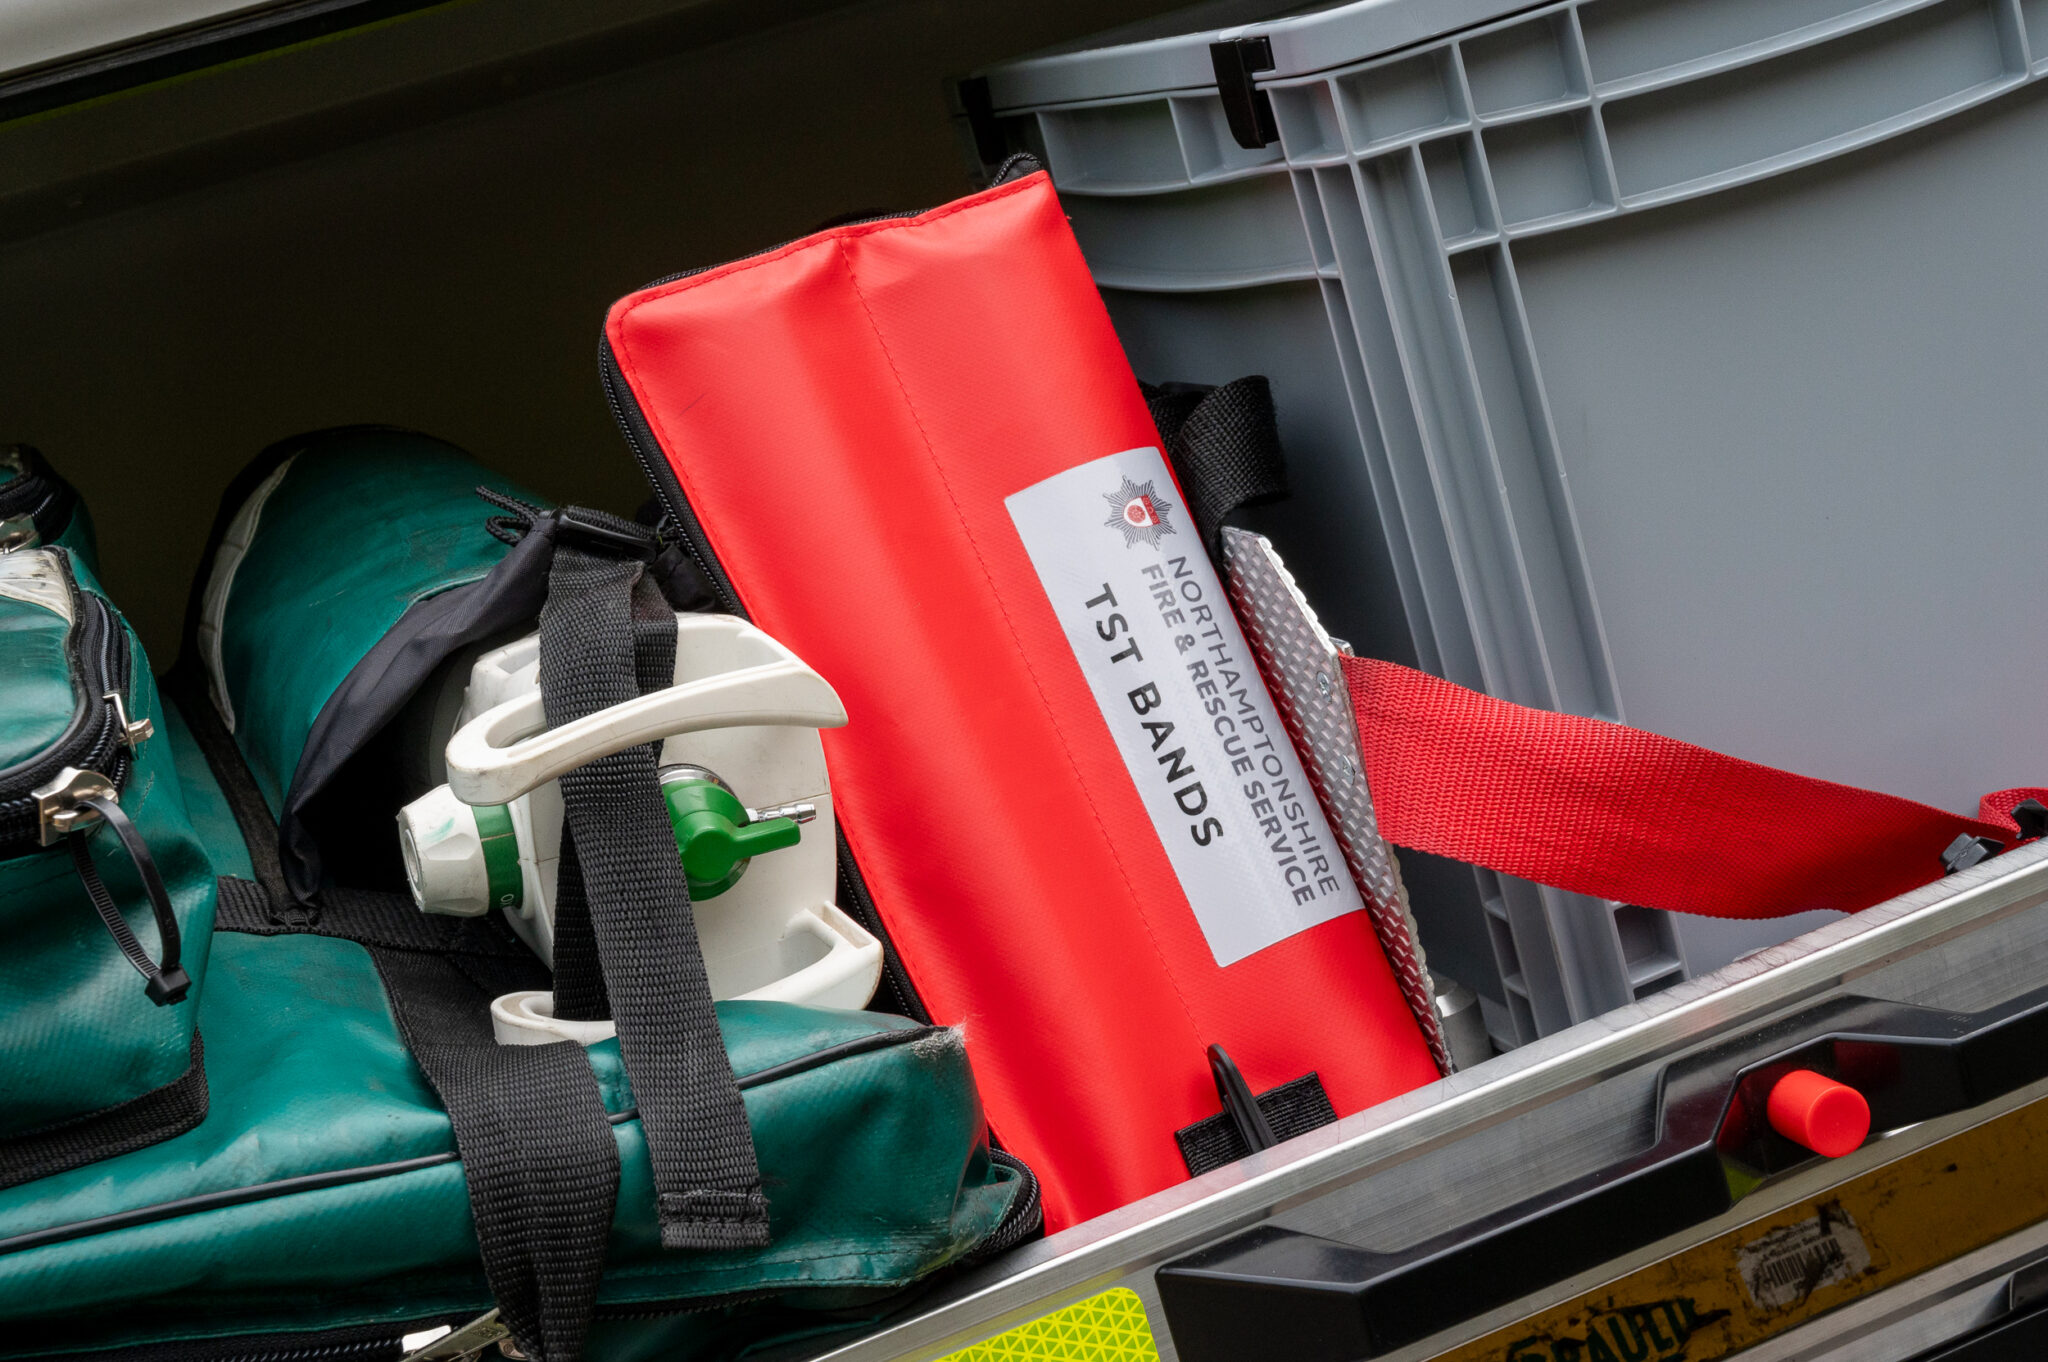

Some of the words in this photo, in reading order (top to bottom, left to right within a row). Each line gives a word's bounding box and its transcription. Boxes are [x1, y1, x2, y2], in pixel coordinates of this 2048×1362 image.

[1085, 582, 1144, 664] TST
[1127, 682, 1224, 847] BANDS
[1141, 563, 1186, 629] FIRE
[1174, 634, 1196, 657] &
[1186, 659, 1255, 777] RESCUE
[1243, 780, 1316, 906] SERVICE
[1167, 556, 1341, 896] NORTHAMPTONSHIRE
